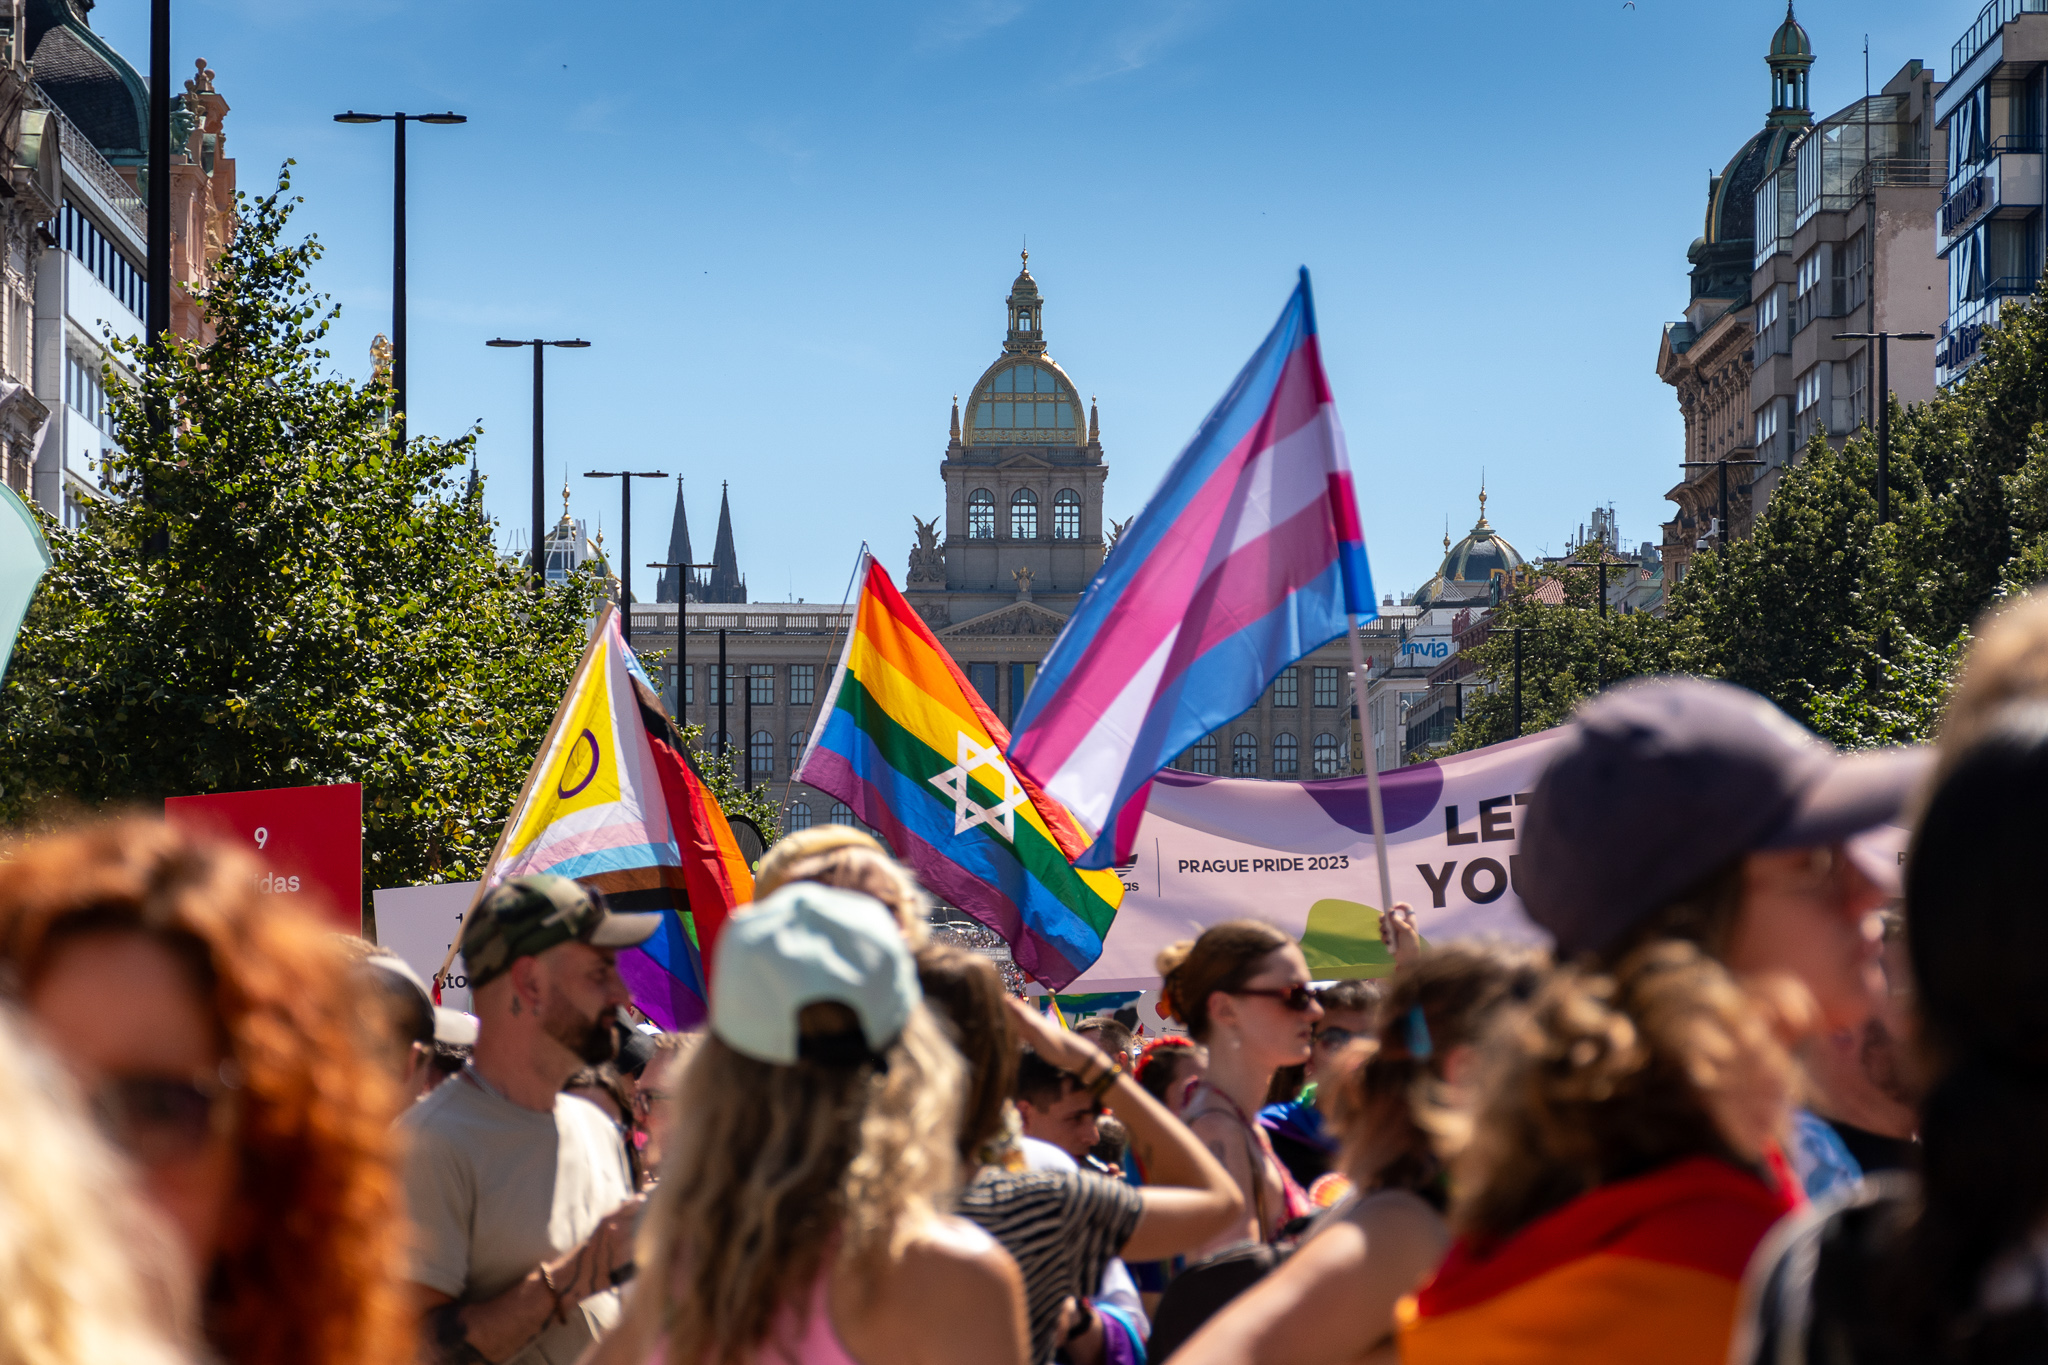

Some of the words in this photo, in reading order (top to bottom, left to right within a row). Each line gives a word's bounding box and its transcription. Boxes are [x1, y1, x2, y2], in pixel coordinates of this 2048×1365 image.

[1402, 638, 1448, 658] invia
[254, 826, 268, 849] 9
[1178, 859, 1249, 873] PRAGUE
[1252, 858, 1304, 872] PRIDE
[1308, 855, 1349, 871] 2023
[254, 872, 300, 894] idas
